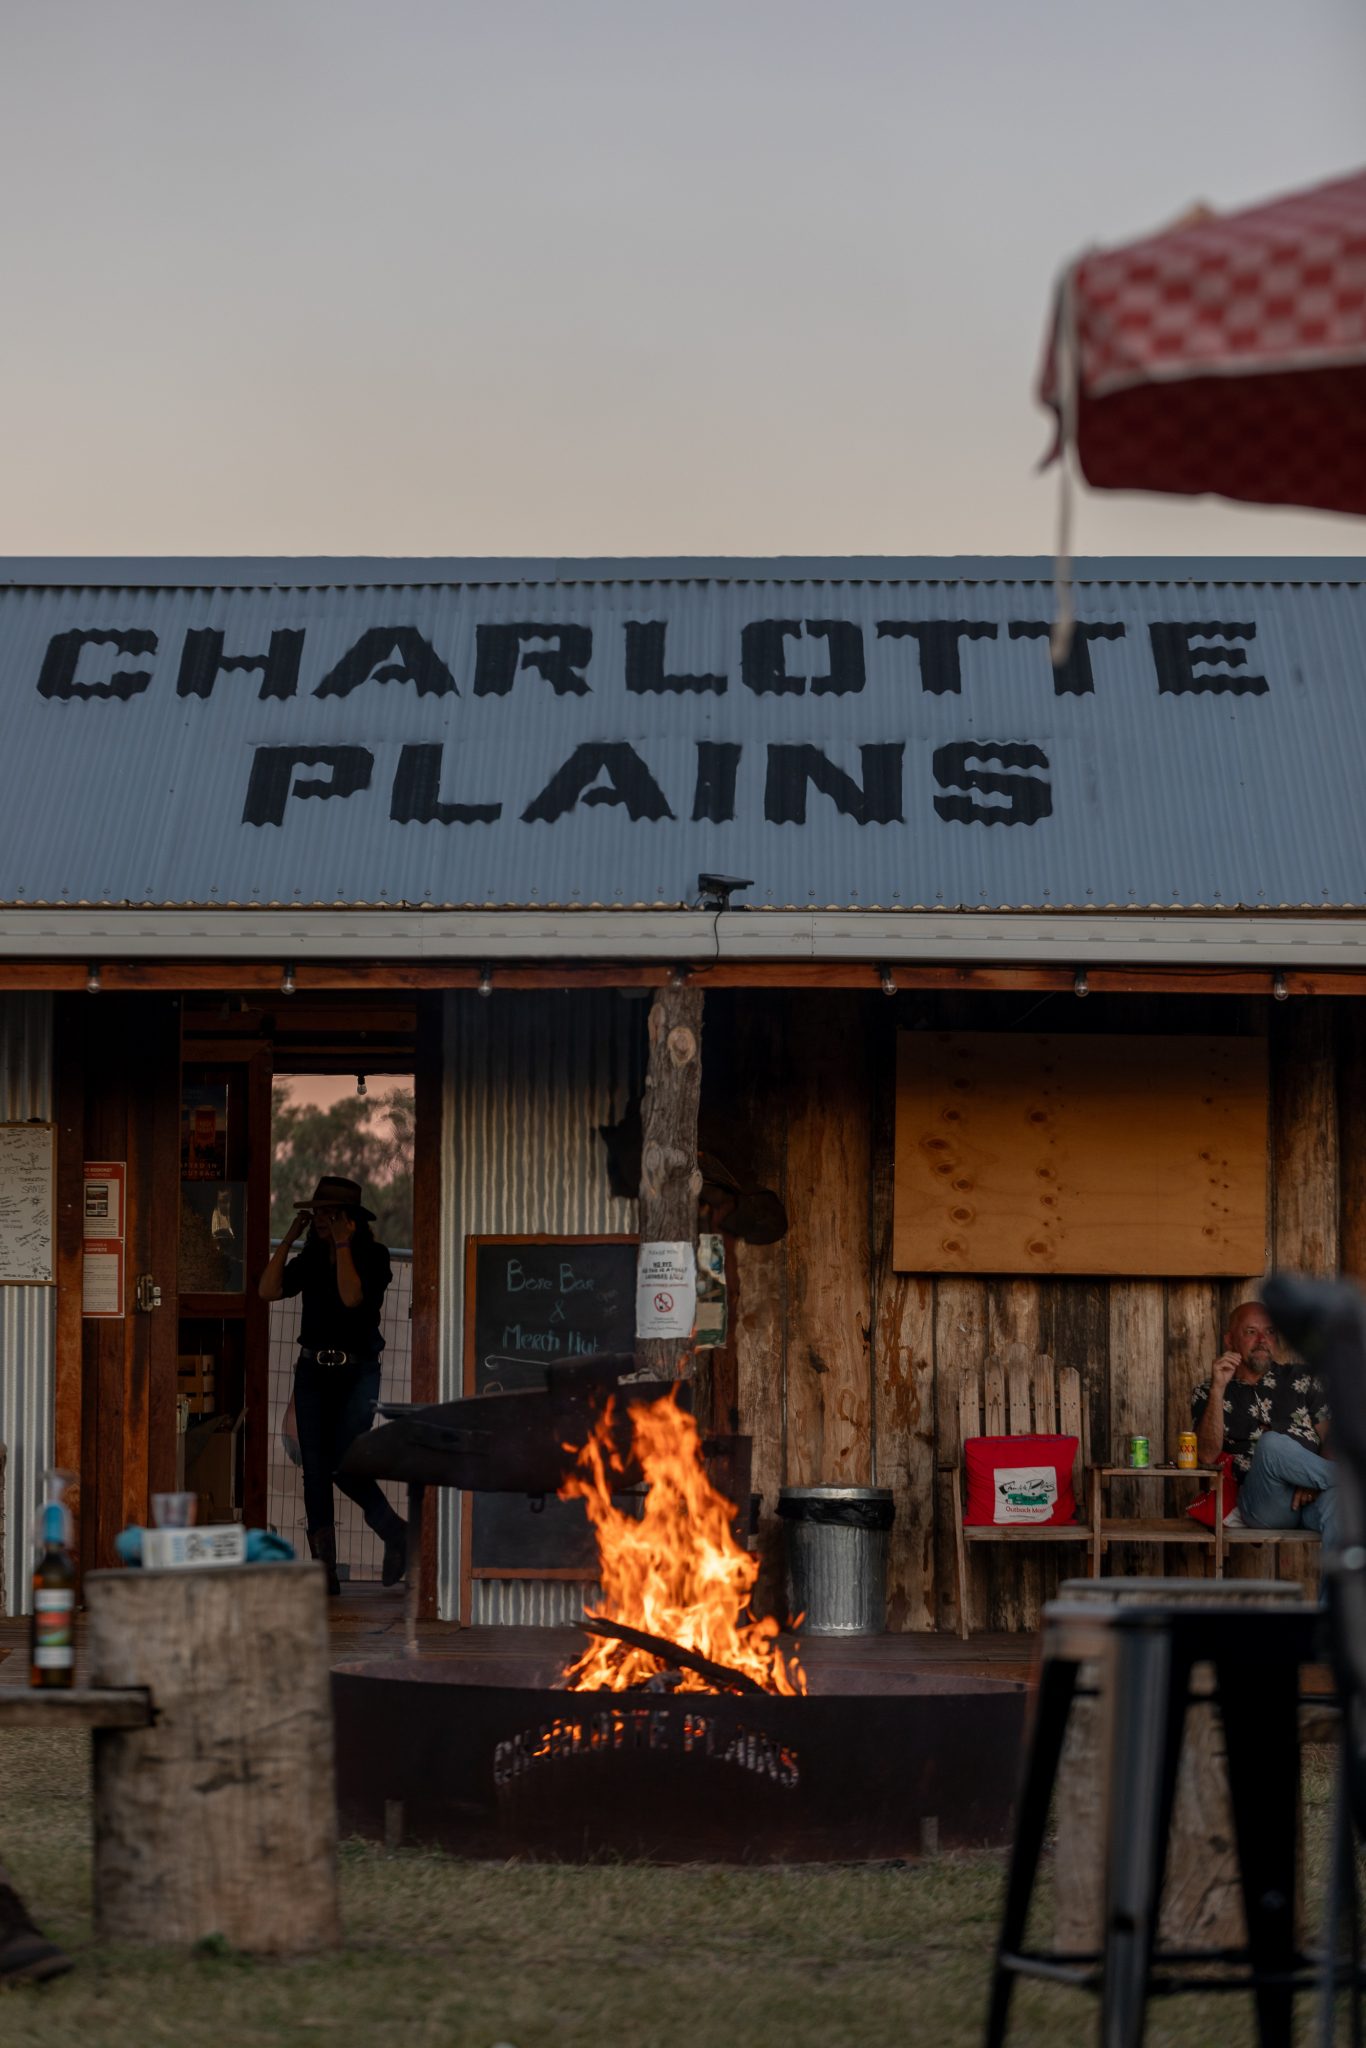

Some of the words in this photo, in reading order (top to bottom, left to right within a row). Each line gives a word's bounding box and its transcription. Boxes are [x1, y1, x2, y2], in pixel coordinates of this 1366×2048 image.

[36, 619, 1270, 700] CHARLOTTE
[242, 740, 1053, 827] PLAINS
[493, 1708, 670, 1786] CHARLOTTE
[683, 1713, 799, 1788] PLAINS
